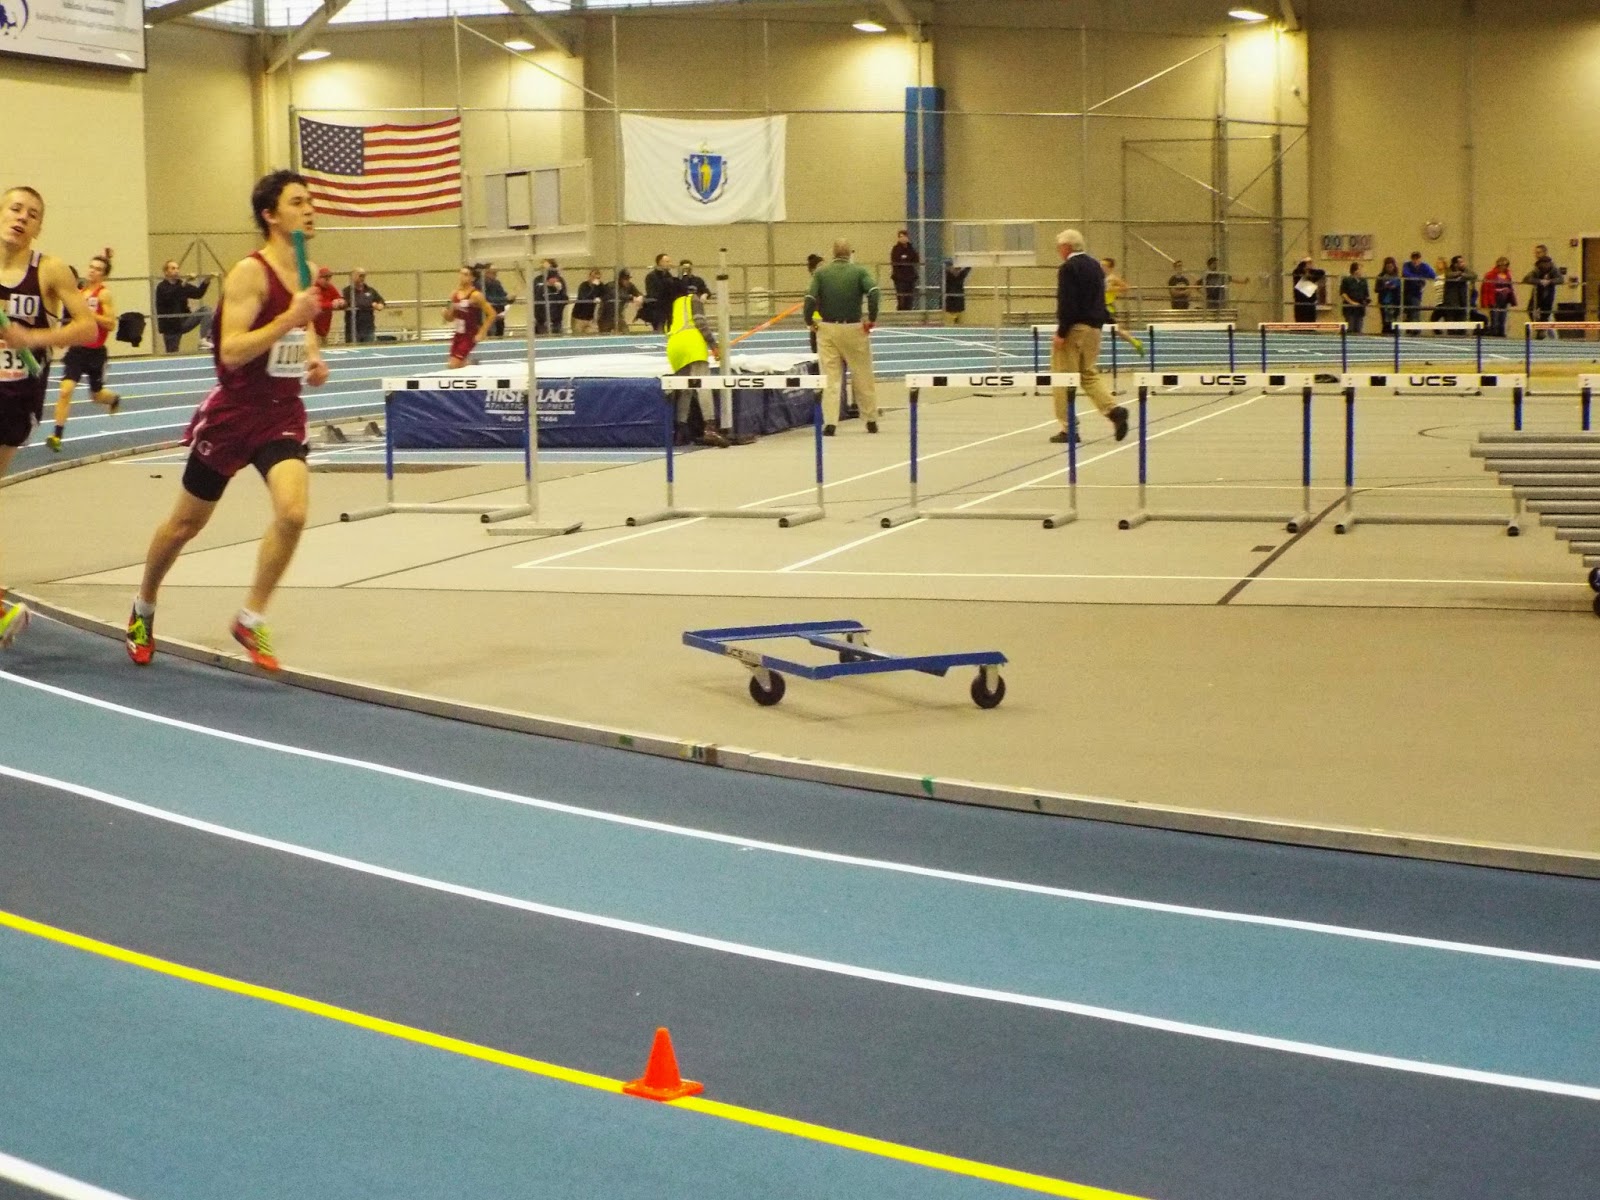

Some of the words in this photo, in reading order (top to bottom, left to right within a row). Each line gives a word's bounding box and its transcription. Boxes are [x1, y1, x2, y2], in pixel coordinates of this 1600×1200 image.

[13, 295, 35, 316] 10
[438, 380, 478, 389] UCS
[723, 378, 764, 388] UCS
[968, 376, 1014, 386] UCS
[1200, 375, 1247, 386] UCS
[1409, 375, 1457, 387] UCS
[535, 388, 575, 402] LACE
